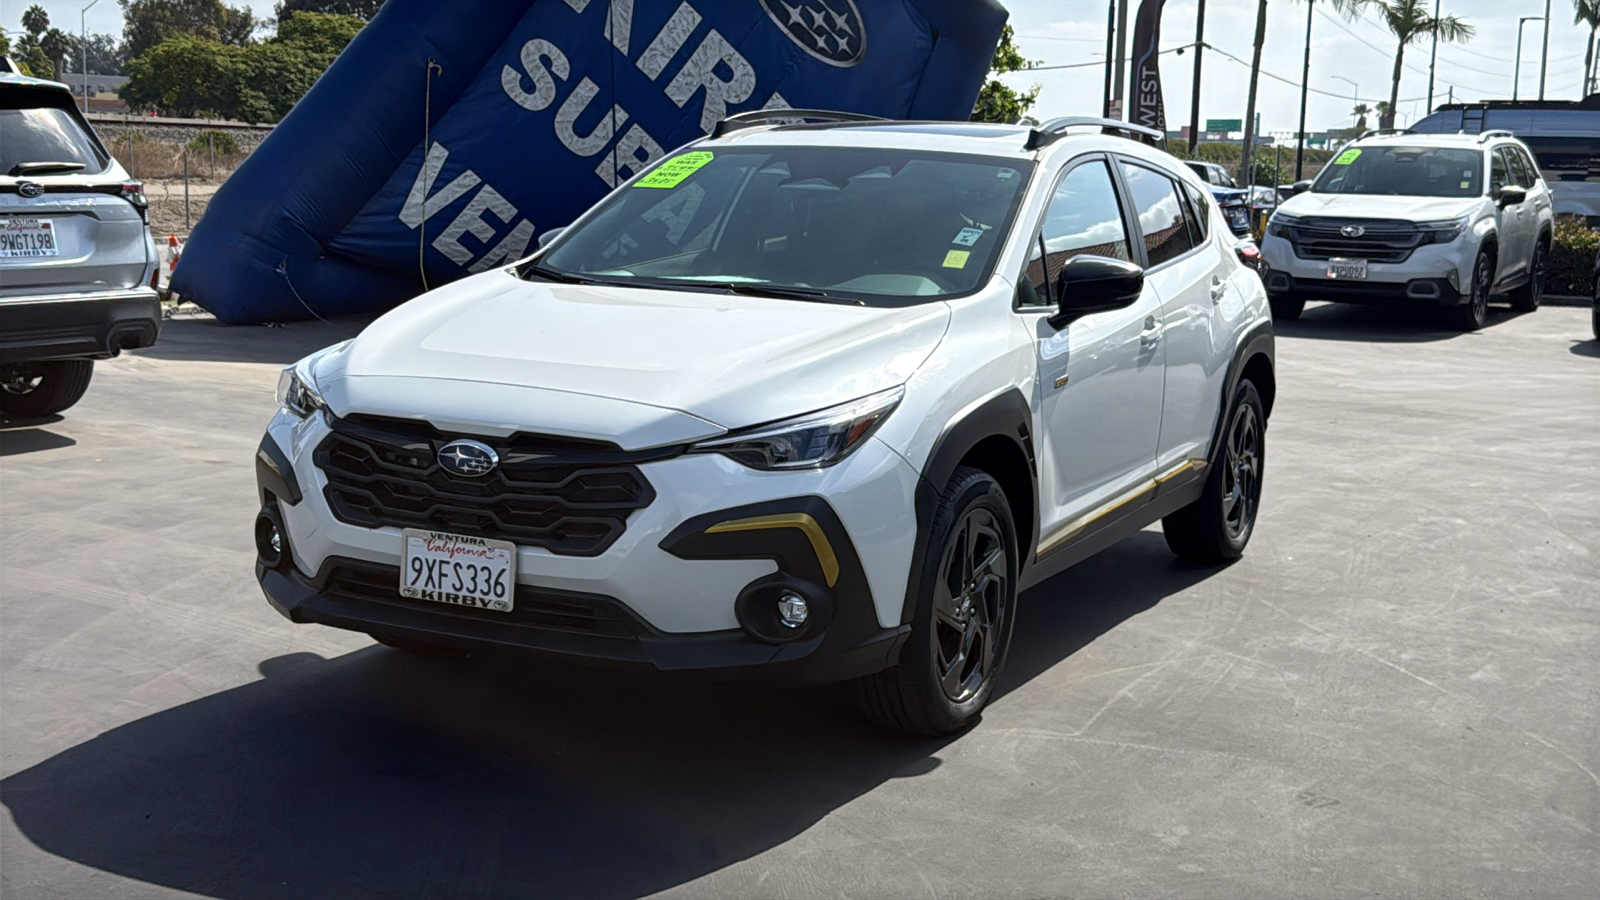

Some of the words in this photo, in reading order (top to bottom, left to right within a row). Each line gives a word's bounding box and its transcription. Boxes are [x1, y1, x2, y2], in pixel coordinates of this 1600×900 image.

[1140, 66, 1157, 127] WEST
[0, 233, 52, 250] 9WGT198
[430, 532, 486, 546] VENTURA
[426, 539, 494, 559] California
[410, 556, 507, 598] 9XFS336
[421, 589, 494, 608] KIRBY
